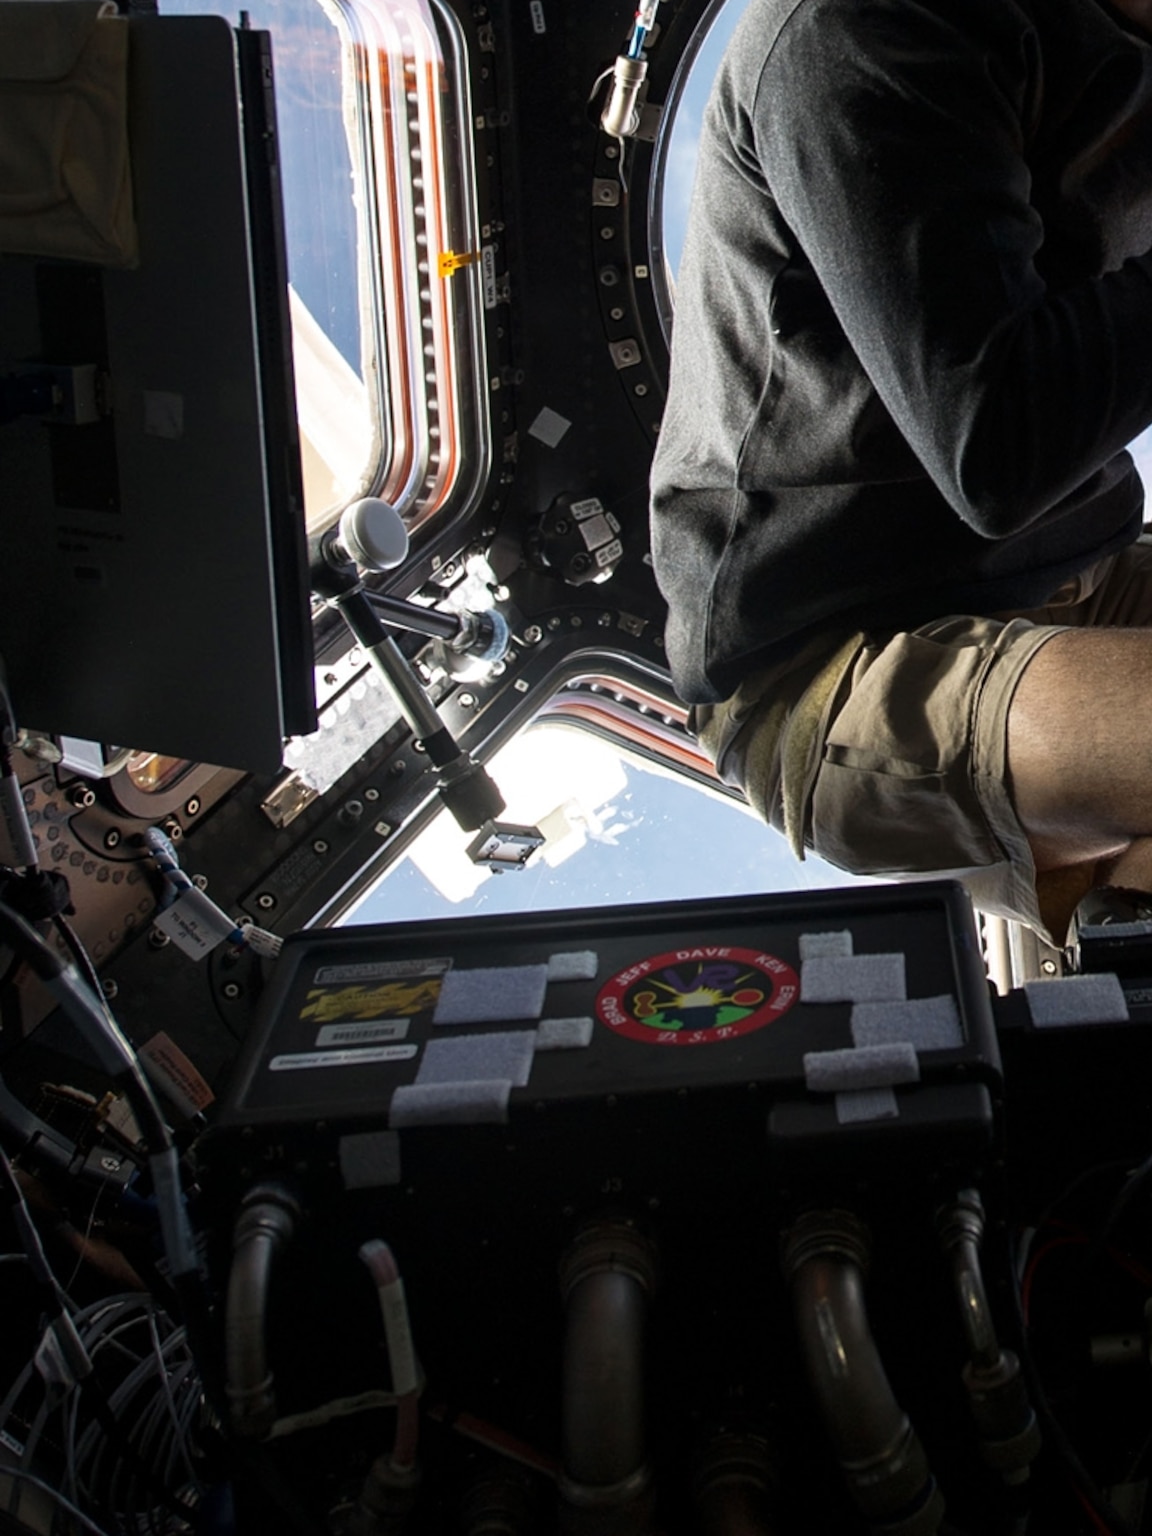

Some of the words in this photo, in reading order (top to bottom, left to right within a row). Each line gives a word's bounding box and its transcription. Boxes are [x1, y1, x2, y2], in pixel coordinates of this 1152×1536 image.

[676, 947, 732, 961] DAVE
[754, 954, 788, 974] KEN
[615, 961, 651, 986] JEFF
[770, 985, 796, 1011] ERIN
[602, 996, 627, 1026] BRAD
